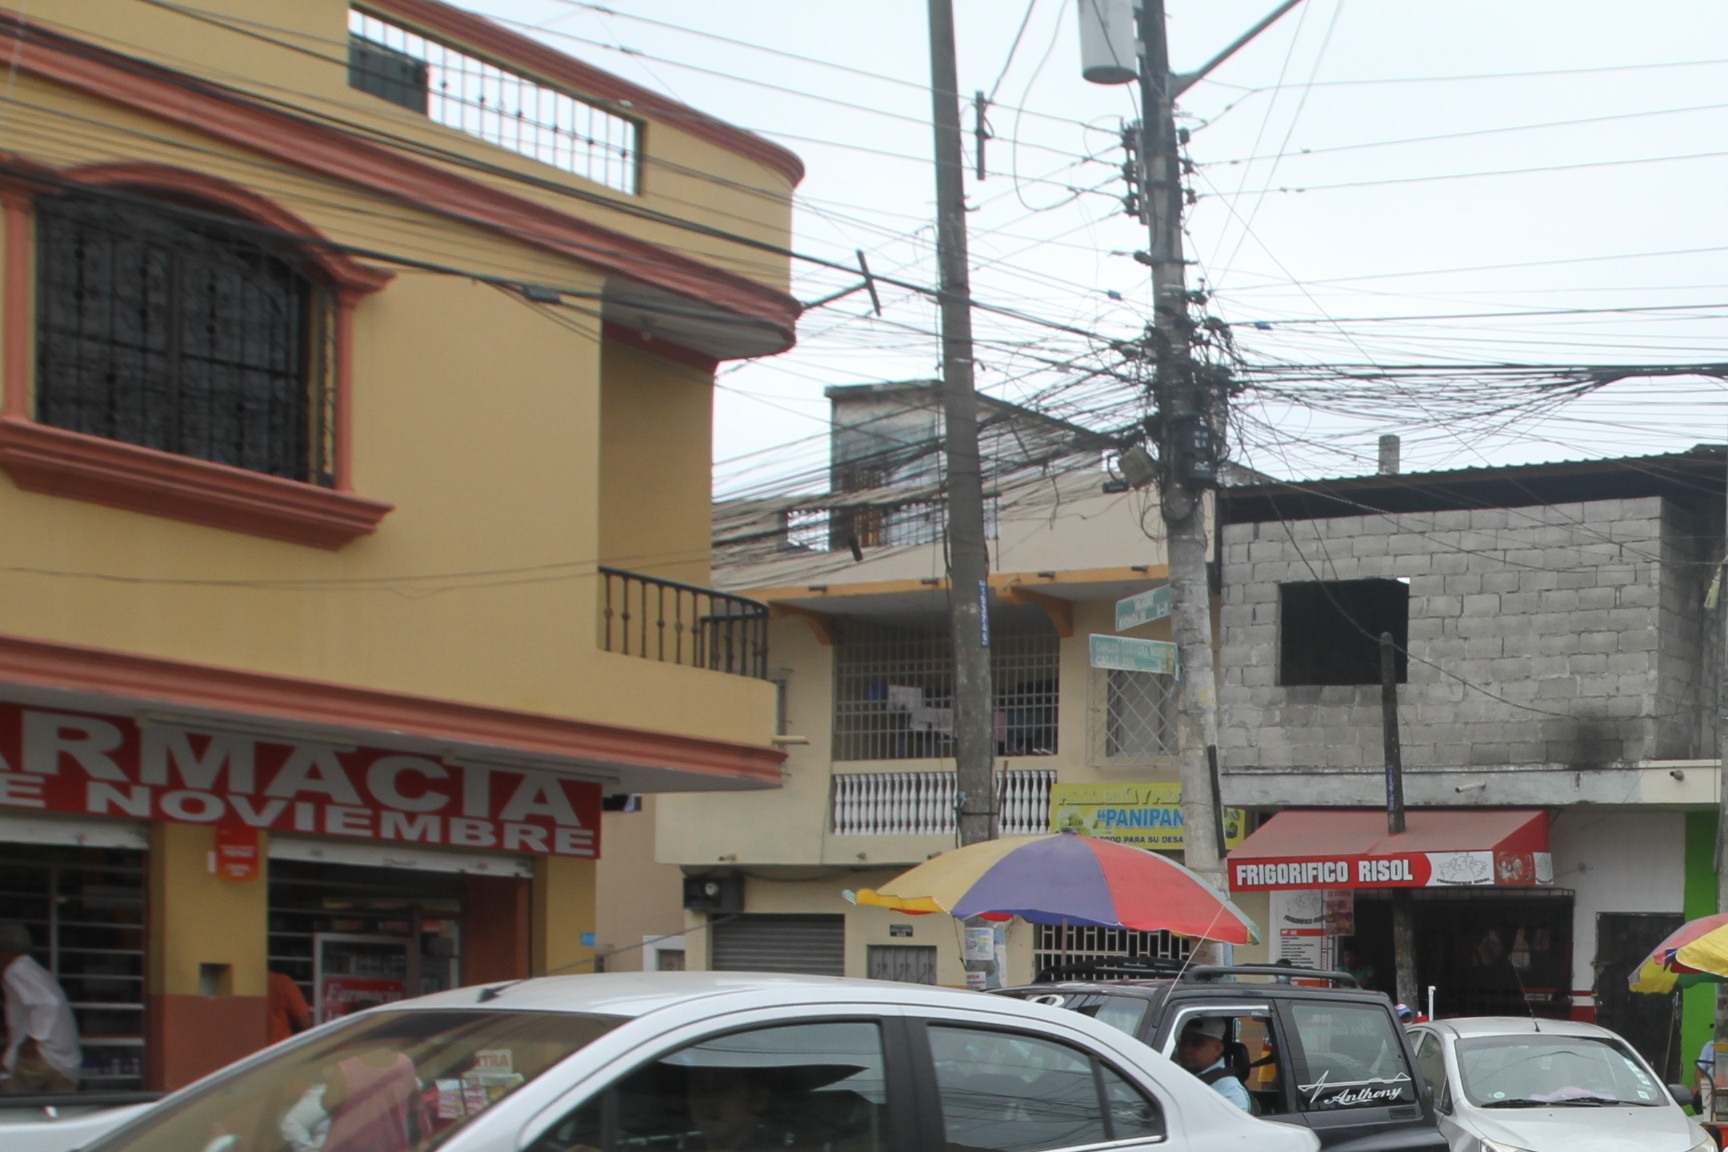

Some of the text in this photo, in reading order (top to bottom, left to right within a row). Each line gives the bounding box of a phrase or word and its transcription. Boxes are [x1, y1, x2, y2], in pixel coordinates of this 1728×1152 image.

[0, 709, 582, 827] RMACIA
[86, 779, 595, 857] NOVIEMBRE
[1123, 836, 1146, 844] PARA
[1147, 836, 1160, 844] SU
[1236, 858, 1414, 886] FRIGORIFICO RISOL
[1323, 1086, 1403, 1106] Anthony
